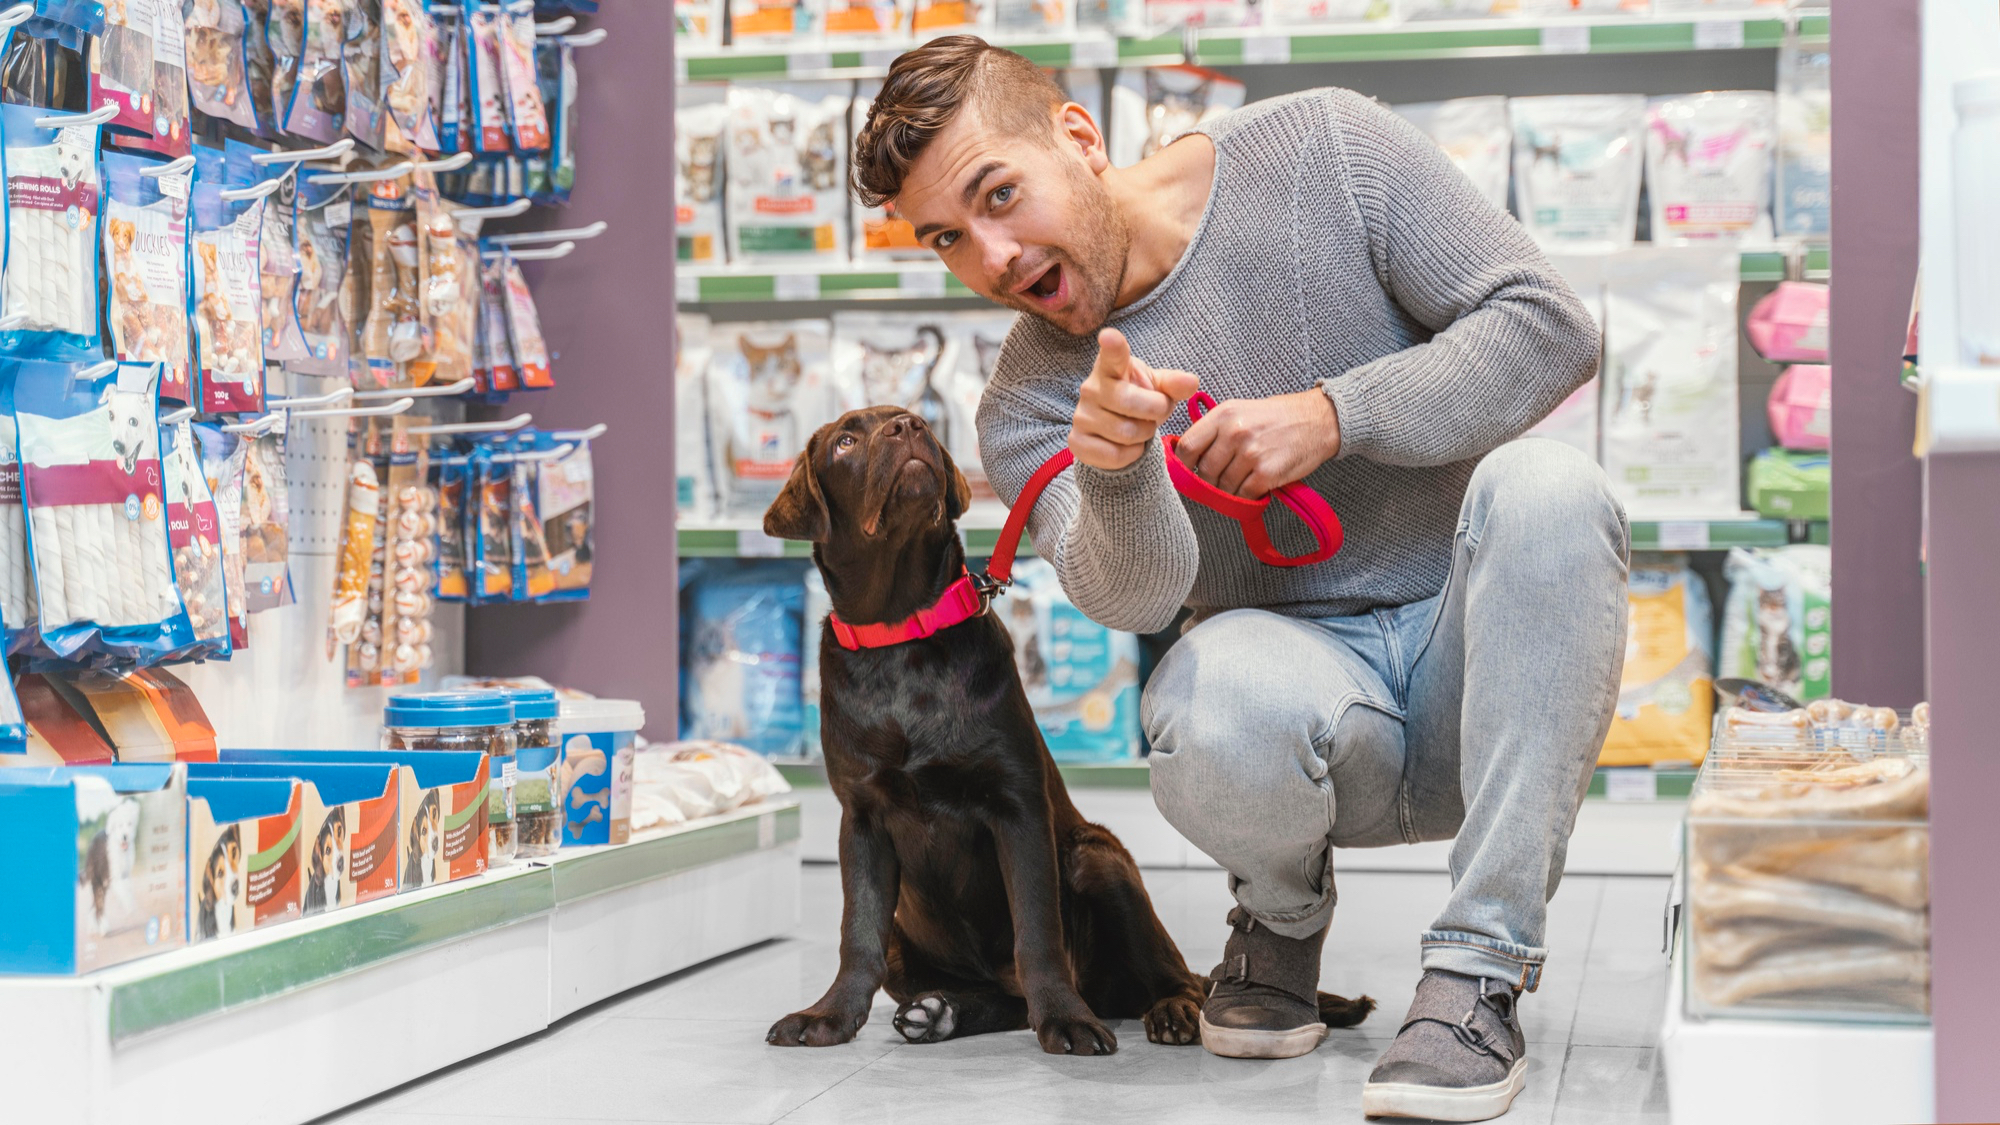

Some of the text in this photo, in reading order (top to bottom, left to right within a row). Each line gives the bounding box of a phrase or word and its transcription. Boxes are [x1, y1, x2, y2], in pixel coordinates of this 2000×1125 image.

[8, 182, 60, 194] CHEWING ROLLS
[136, 231, 170, 256] DUCKIES
[170, 520, 189, 531] ROLLS
